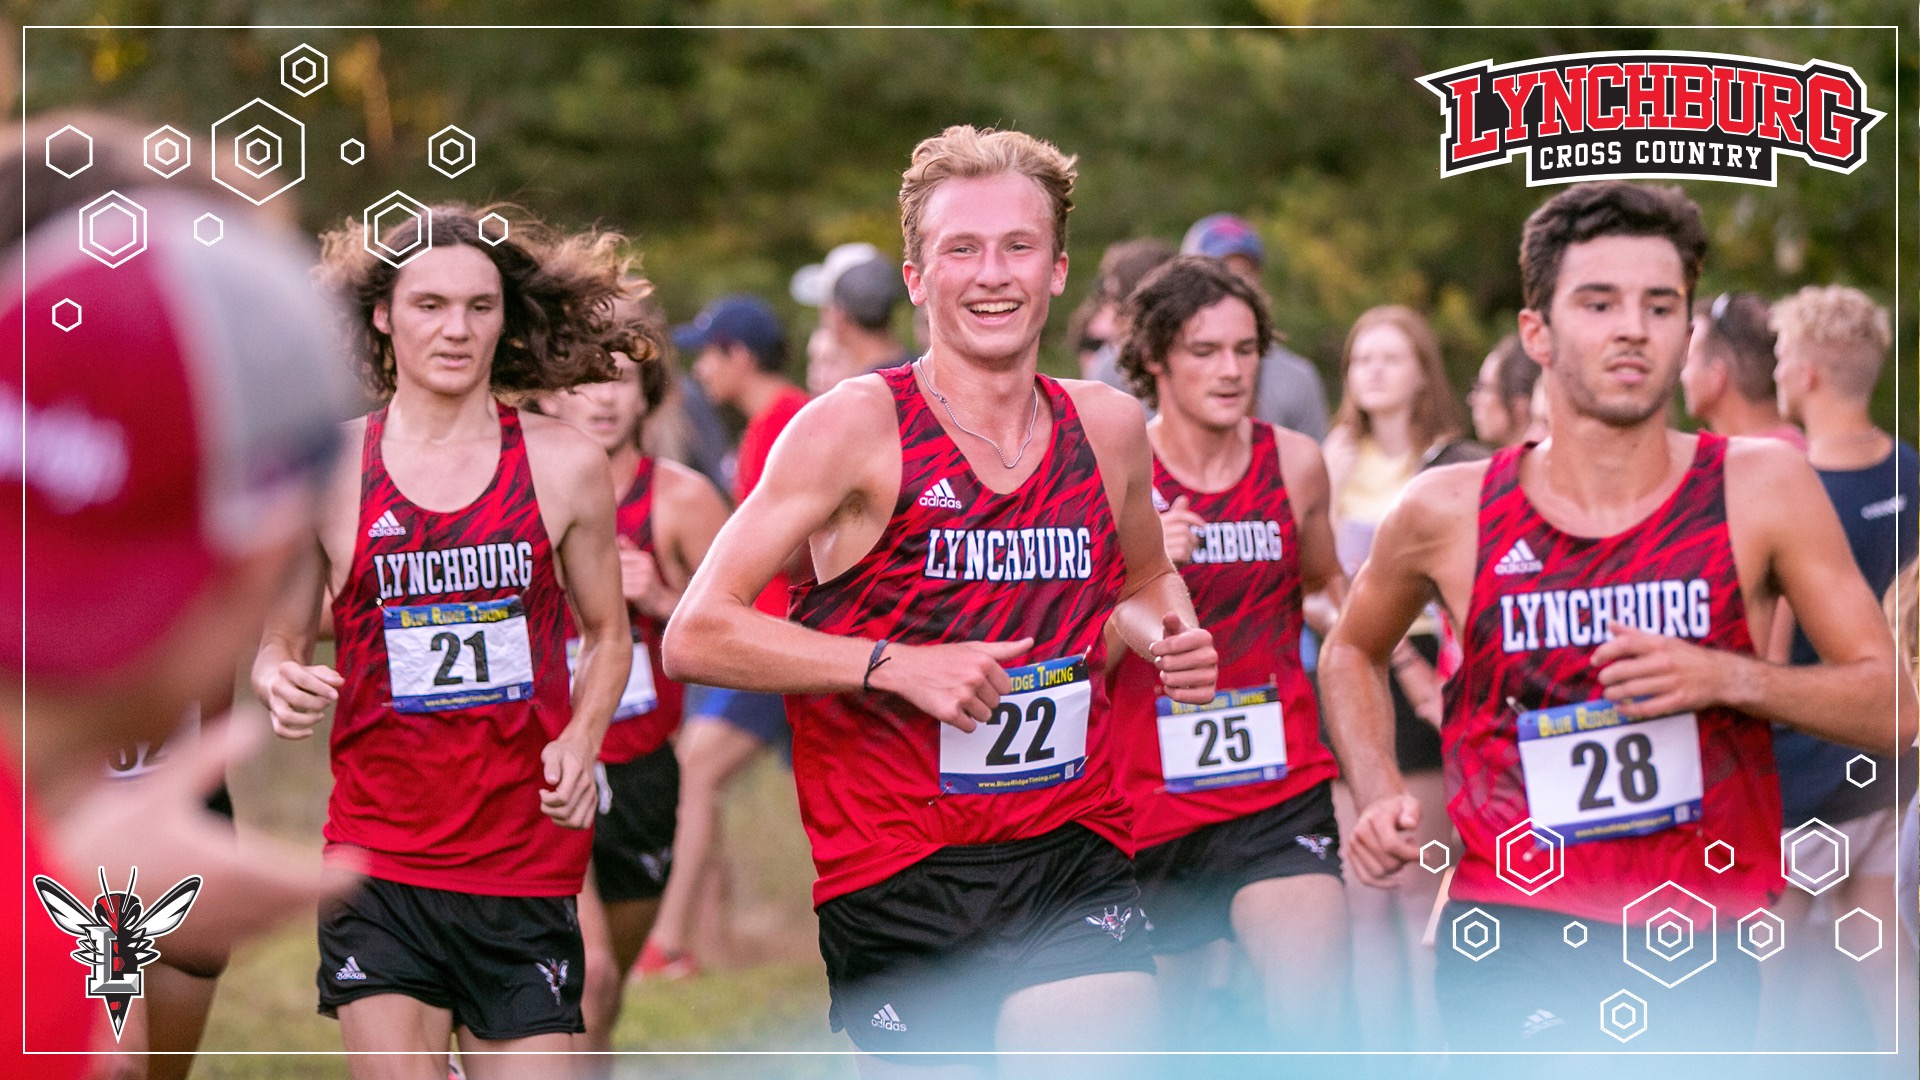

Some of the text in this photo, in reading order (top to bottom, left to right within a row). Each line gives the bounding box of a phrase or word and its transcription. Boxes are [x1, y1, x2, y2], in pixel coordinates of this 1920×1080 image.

[918, 496, 962, 510] adidas
[367, 525, 407, 538] adidas
[924, 526, 1093, 581] LYNCHBURG
[1190, 520, 1283, 564] CHBURG
[373, 541, 533, 600] LYNCHBURG
[1500, 578, 1711, 654] LYNCHBURG
[430, 630, 491, 687] 21
[1010, 674, 1035, 692] IDGE
[985, 696, 1057, 766] 22
[1194, 714, 1252, 767] 25
[1571, 732, 1659, 812] 28
[871, 1017, 908, 1032] adidas
